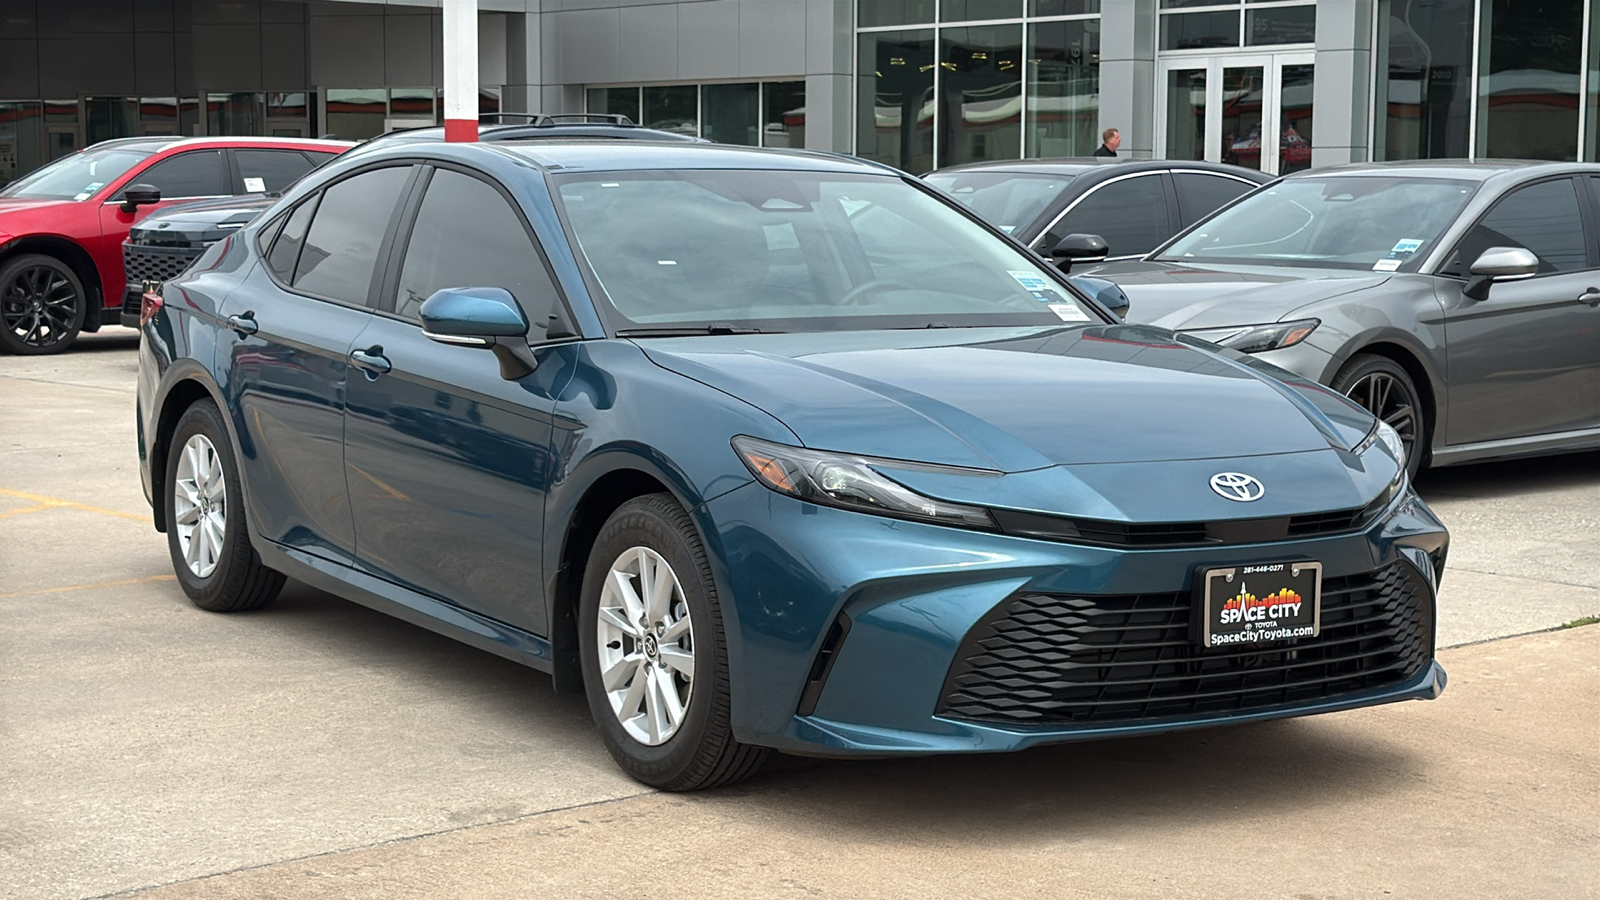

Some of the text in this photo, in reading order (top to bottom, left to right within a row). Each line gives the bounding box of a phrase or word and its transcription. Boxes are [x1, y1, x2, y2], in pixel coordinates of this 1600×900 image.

[1431, 70, 1452, 79] 2010
[1243, 564, 1284, 574] 281-446-0271
[1220, 602, 1302, 624] SPACE CITY
[1254, 620, 1278, 629] TOYOTA
[1211, 626, 1313, 645] SpaceCityToyota.com
